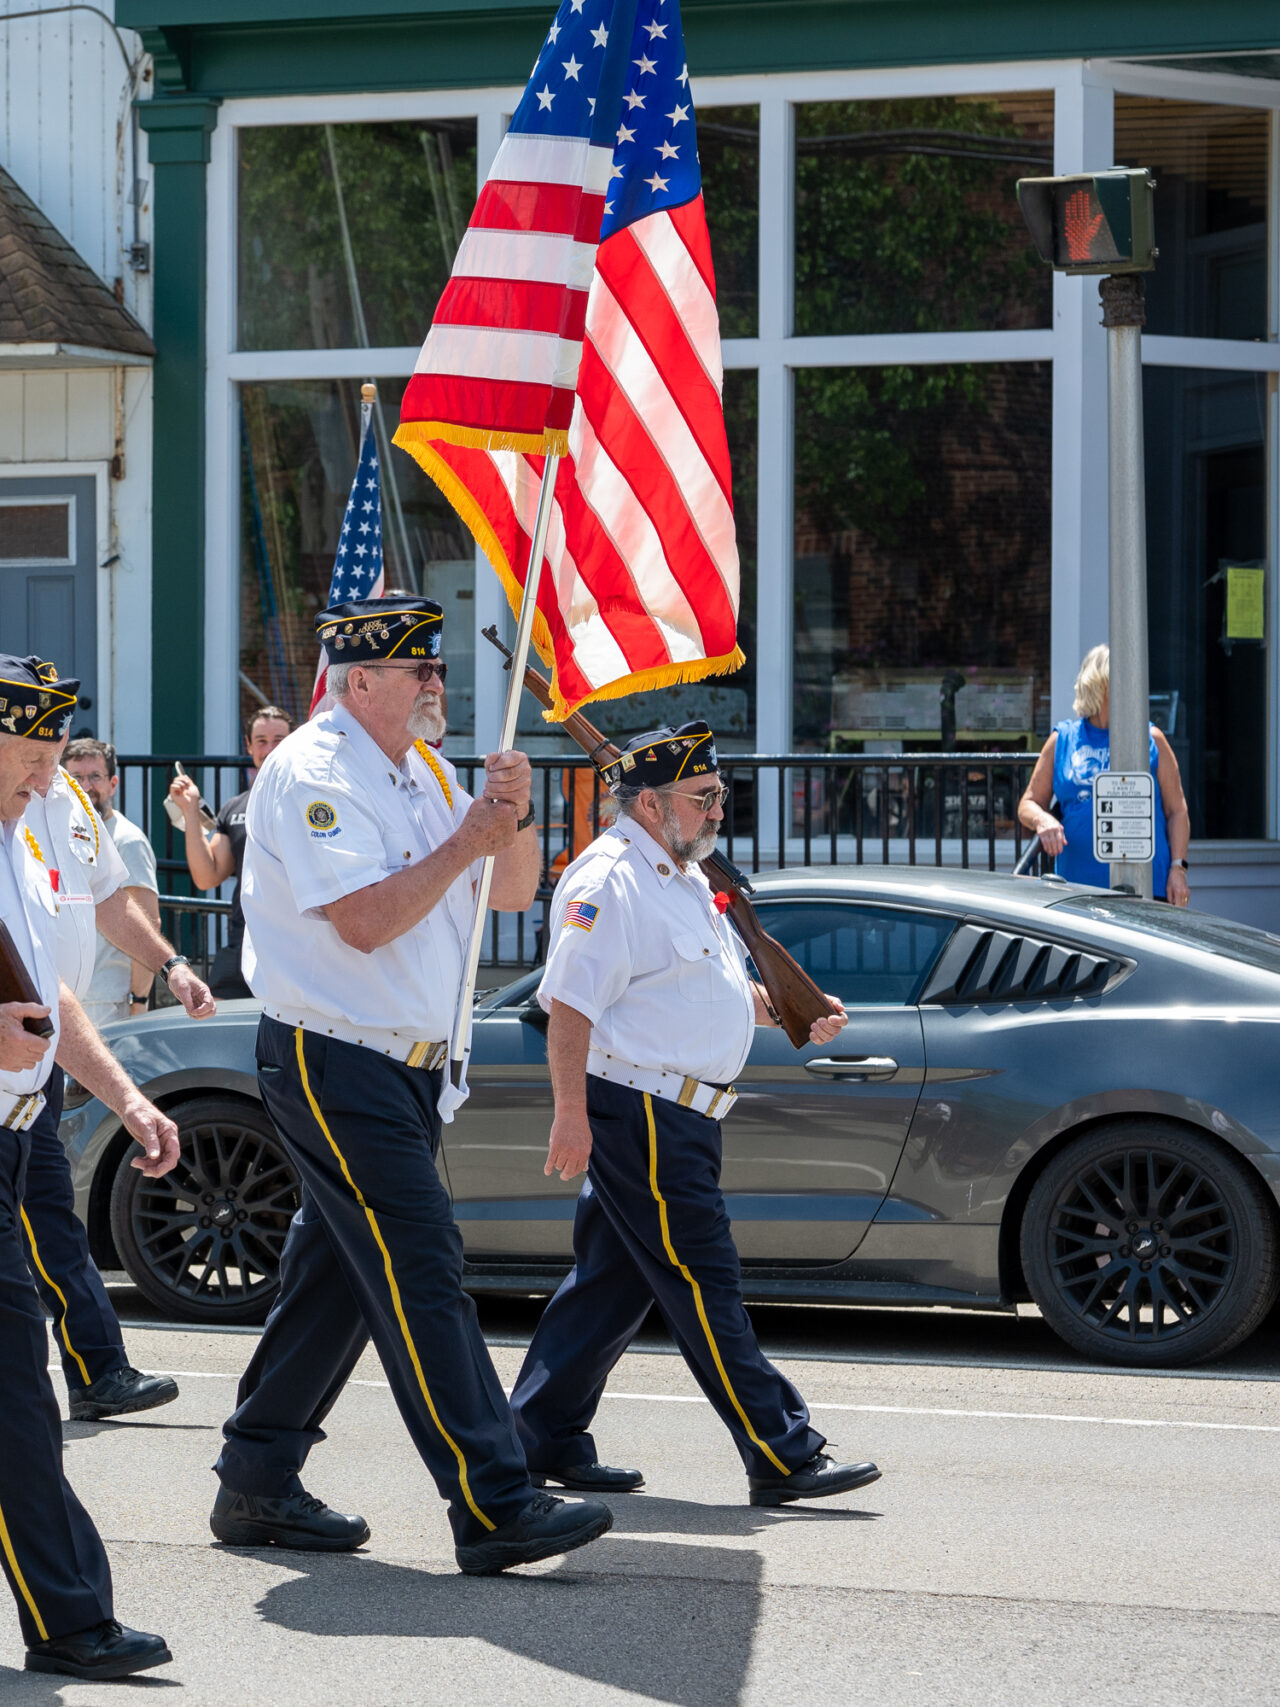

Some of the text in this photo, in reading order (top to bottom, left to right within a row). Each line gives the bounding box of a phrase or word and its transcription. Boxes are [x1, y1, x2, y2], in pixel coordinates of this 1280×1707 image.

[411, 647, 426, 656] 814
[38, 726, 54, 738] 814
[693, 764, 707, 773] 814
[1157, 1136, 1221, 1173] COOPER
